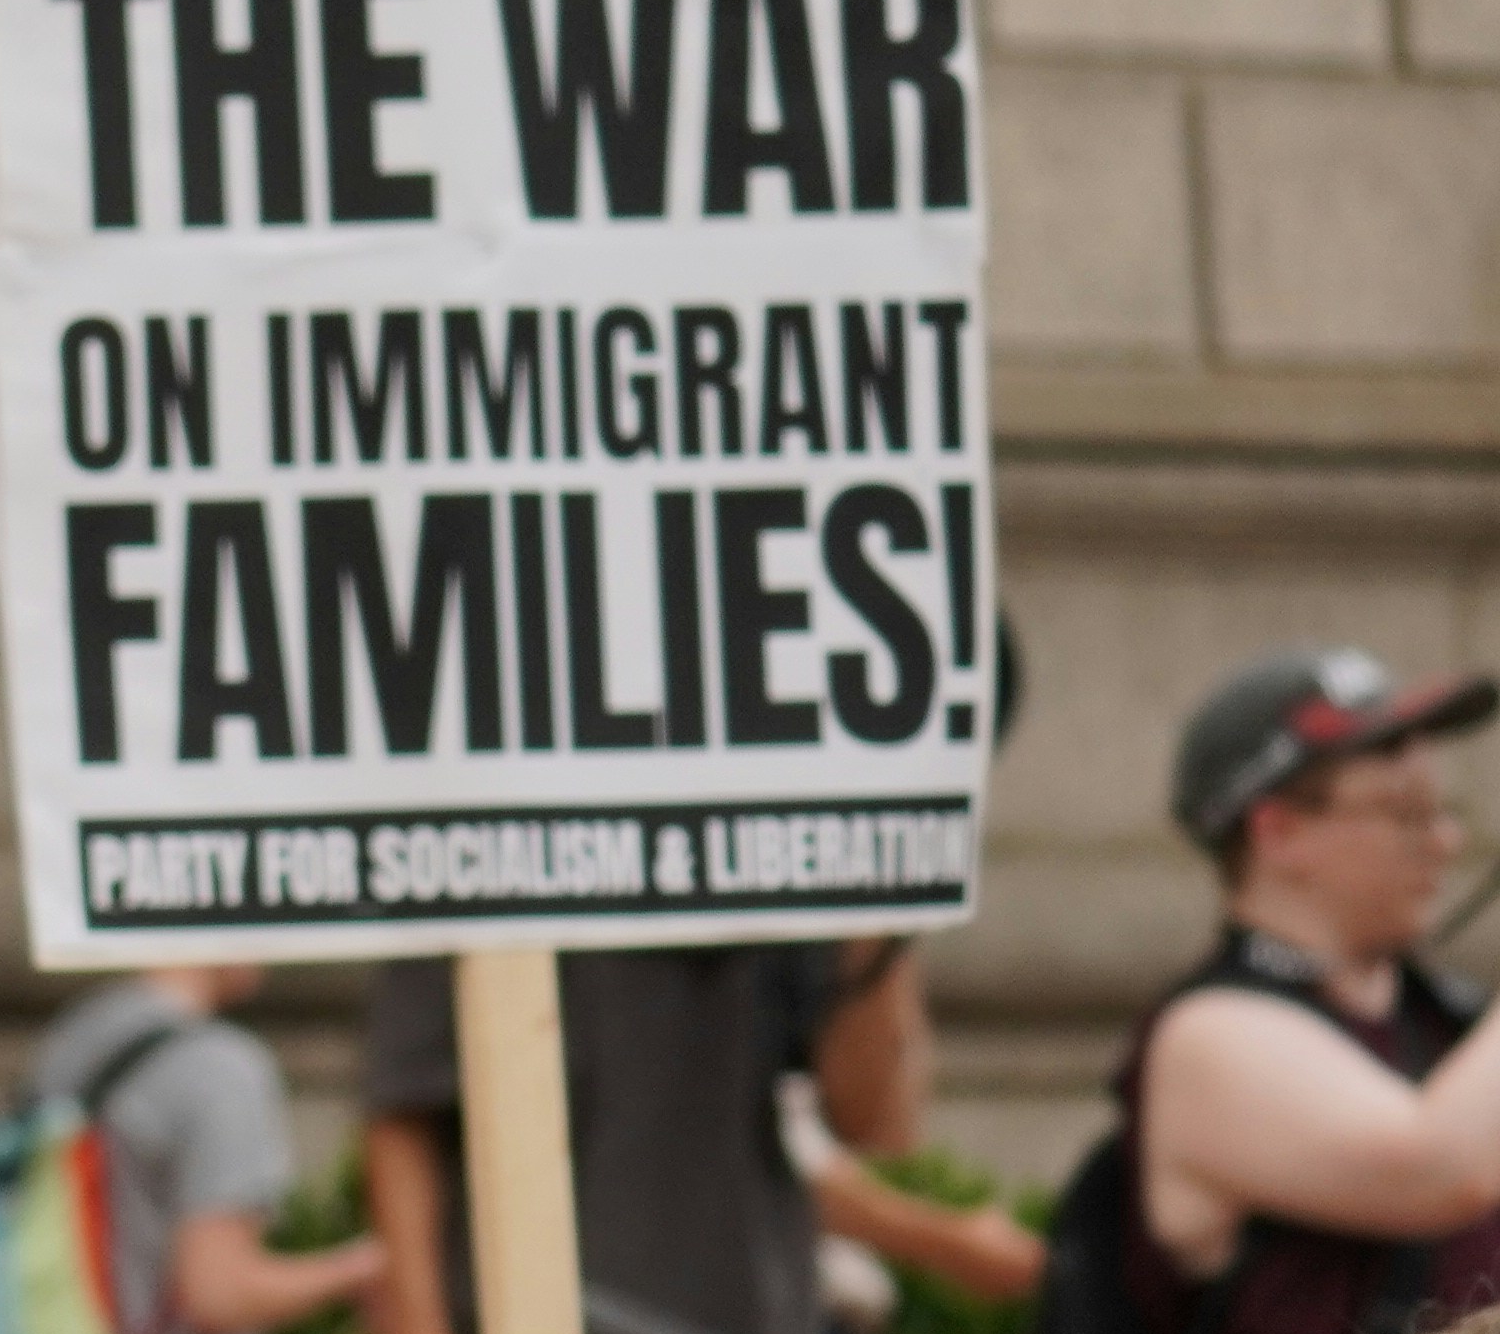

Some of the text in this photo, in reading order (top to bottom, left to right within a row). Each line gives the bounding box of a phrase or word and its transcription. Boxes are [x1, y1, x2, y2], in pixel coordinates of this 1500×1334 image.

[57, 299, 970, 470] ON IMMIGRANT
[64, 480, 976, 764] FAMILIES!
[88, 810, 970, 914] PARTY FOR SOCIALISM & LIBERATION
